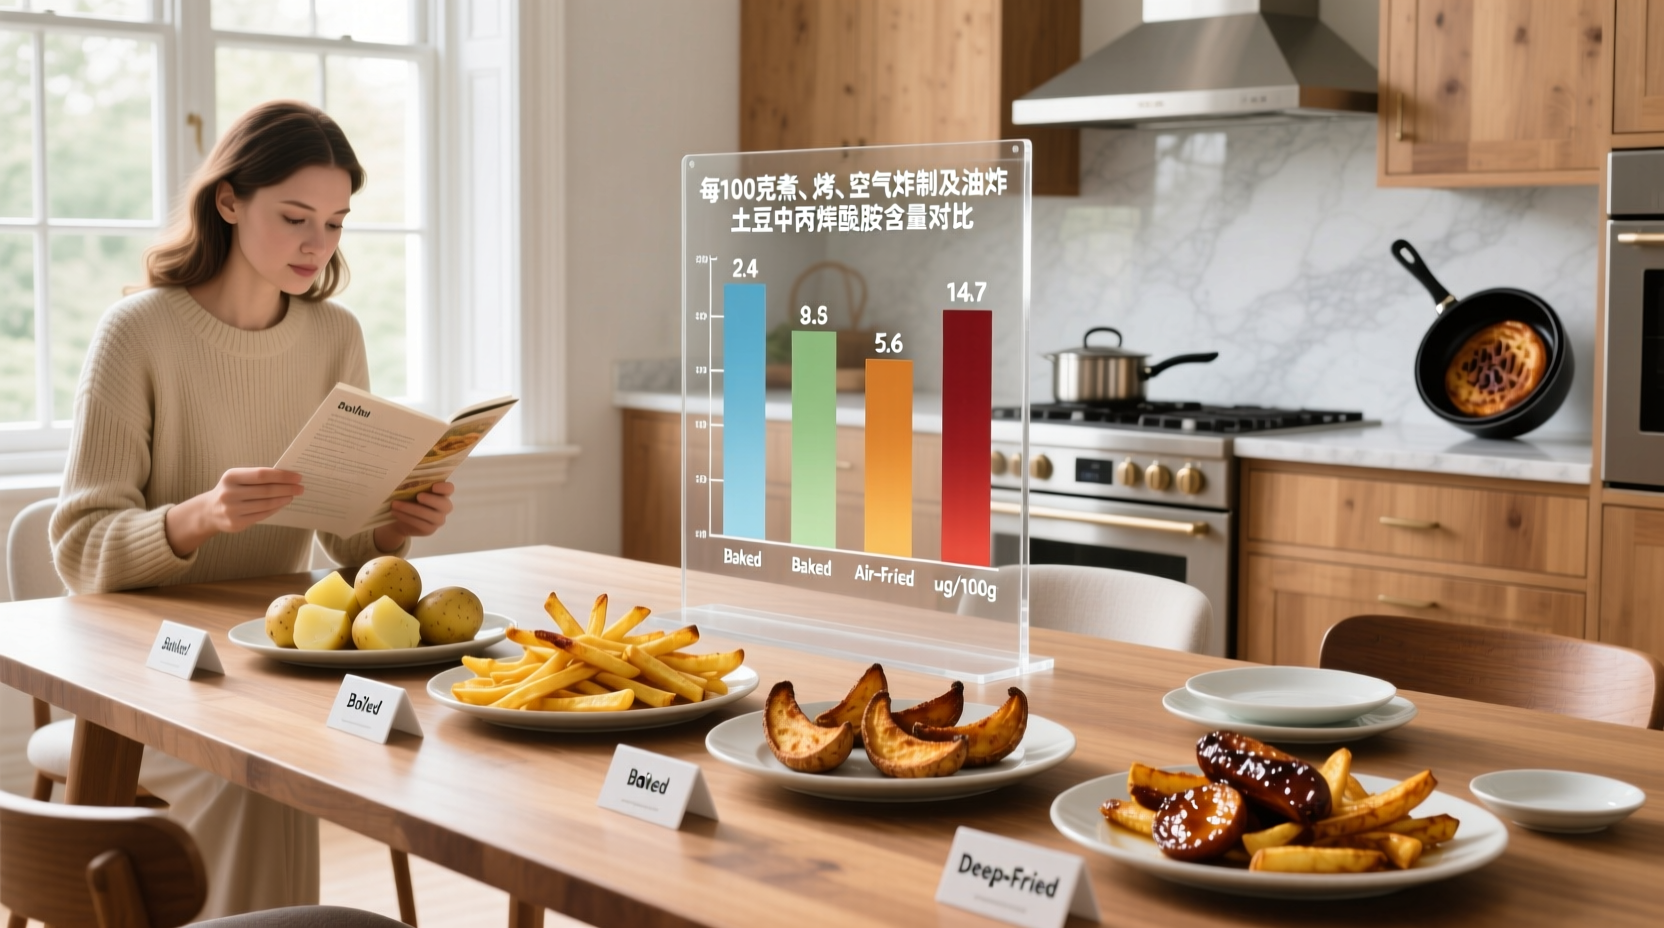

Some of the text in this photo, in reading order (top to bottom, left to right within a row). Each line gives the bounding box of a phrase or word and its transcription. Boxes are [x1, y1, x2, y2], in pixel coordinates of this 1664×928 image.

[732, 258, 758, 278] 2.4
[946, 281, 987, 302] 14.7
[874, 332, 903, 353] 5.6
[723, 547, 762, 567] Baked
[791, 556, 832, 576] Baked
[854, 564, 915, 587] Air-Fried
[934, 574, 997, 602] ug/100g
[958, 853, 1060, 898] Deep-Fried
